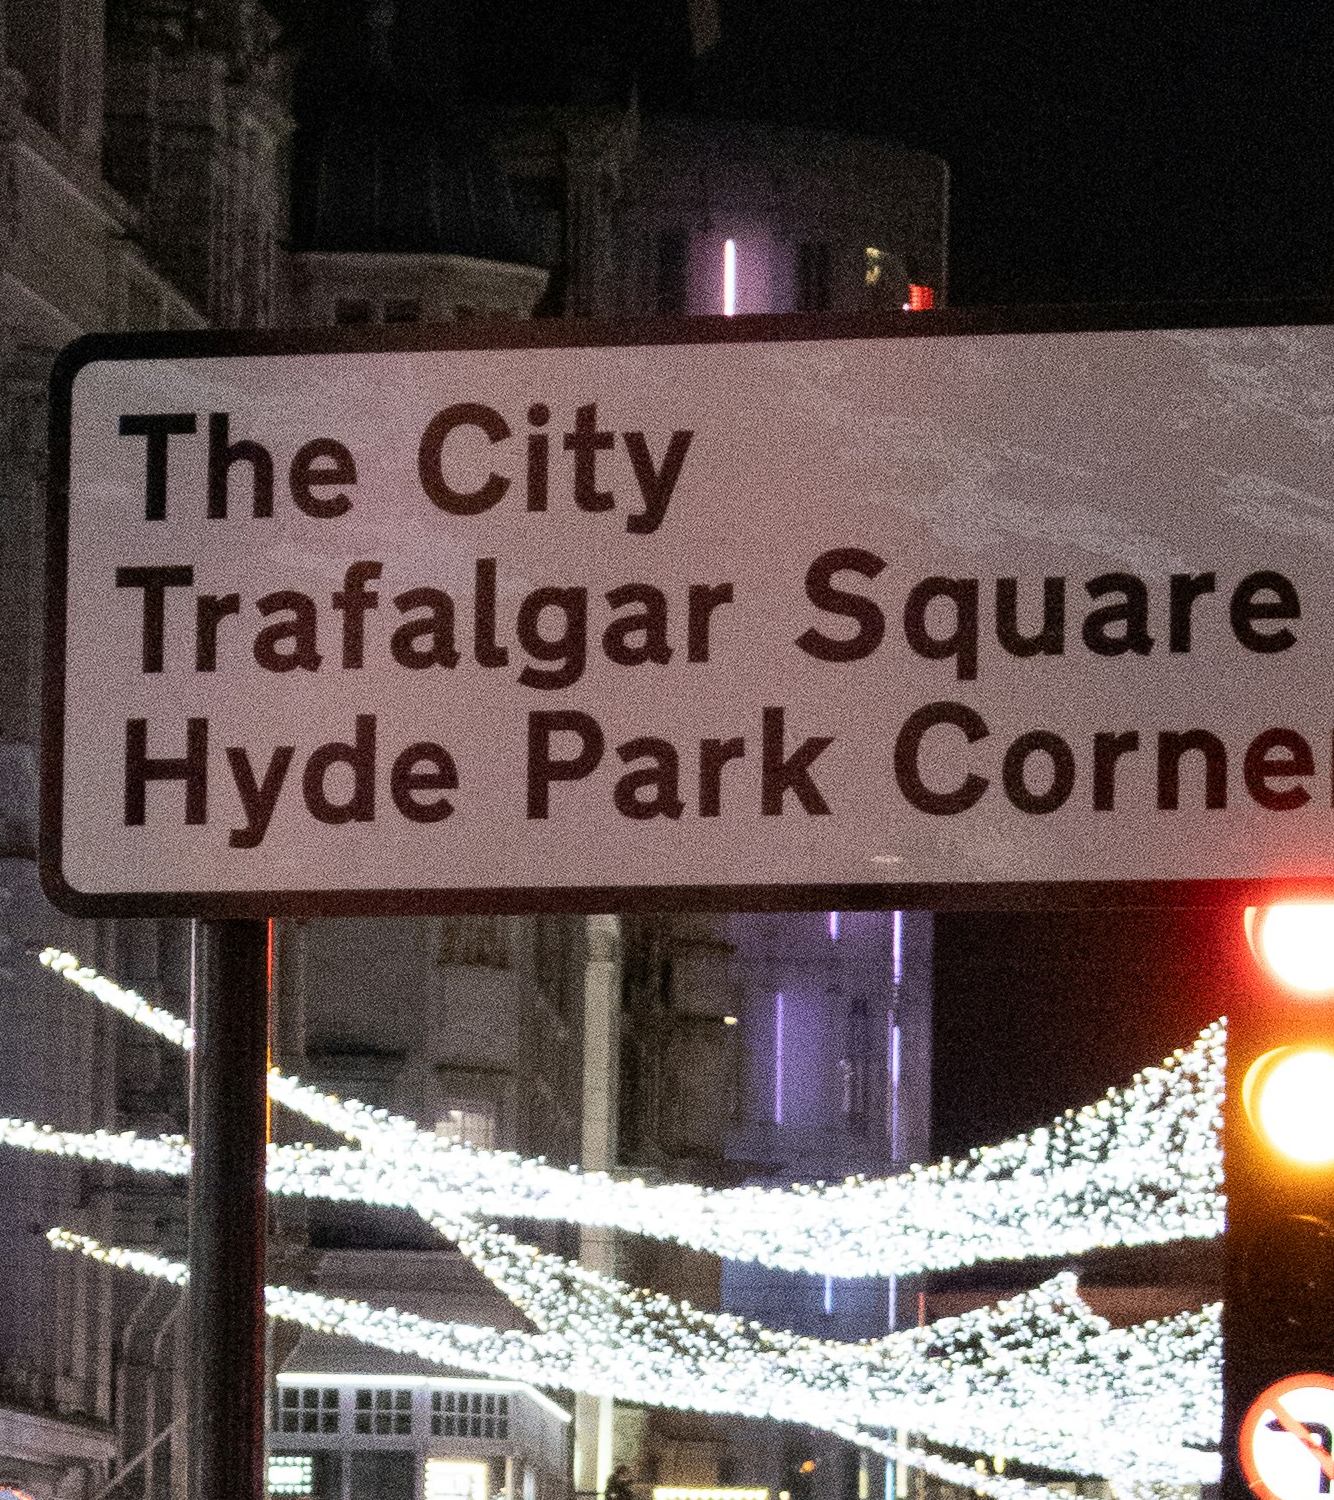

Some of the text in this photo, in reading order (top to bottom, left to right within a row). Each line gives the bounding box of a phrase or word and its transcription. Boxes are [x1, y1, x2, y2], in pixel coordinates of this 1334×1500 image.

[118, 401, 694, 536] The City
[117, 546, 1303, 688] Trafalgar Square
[124, 714, 458, 849] Hyde
[528, 707, 835, 820] Park
